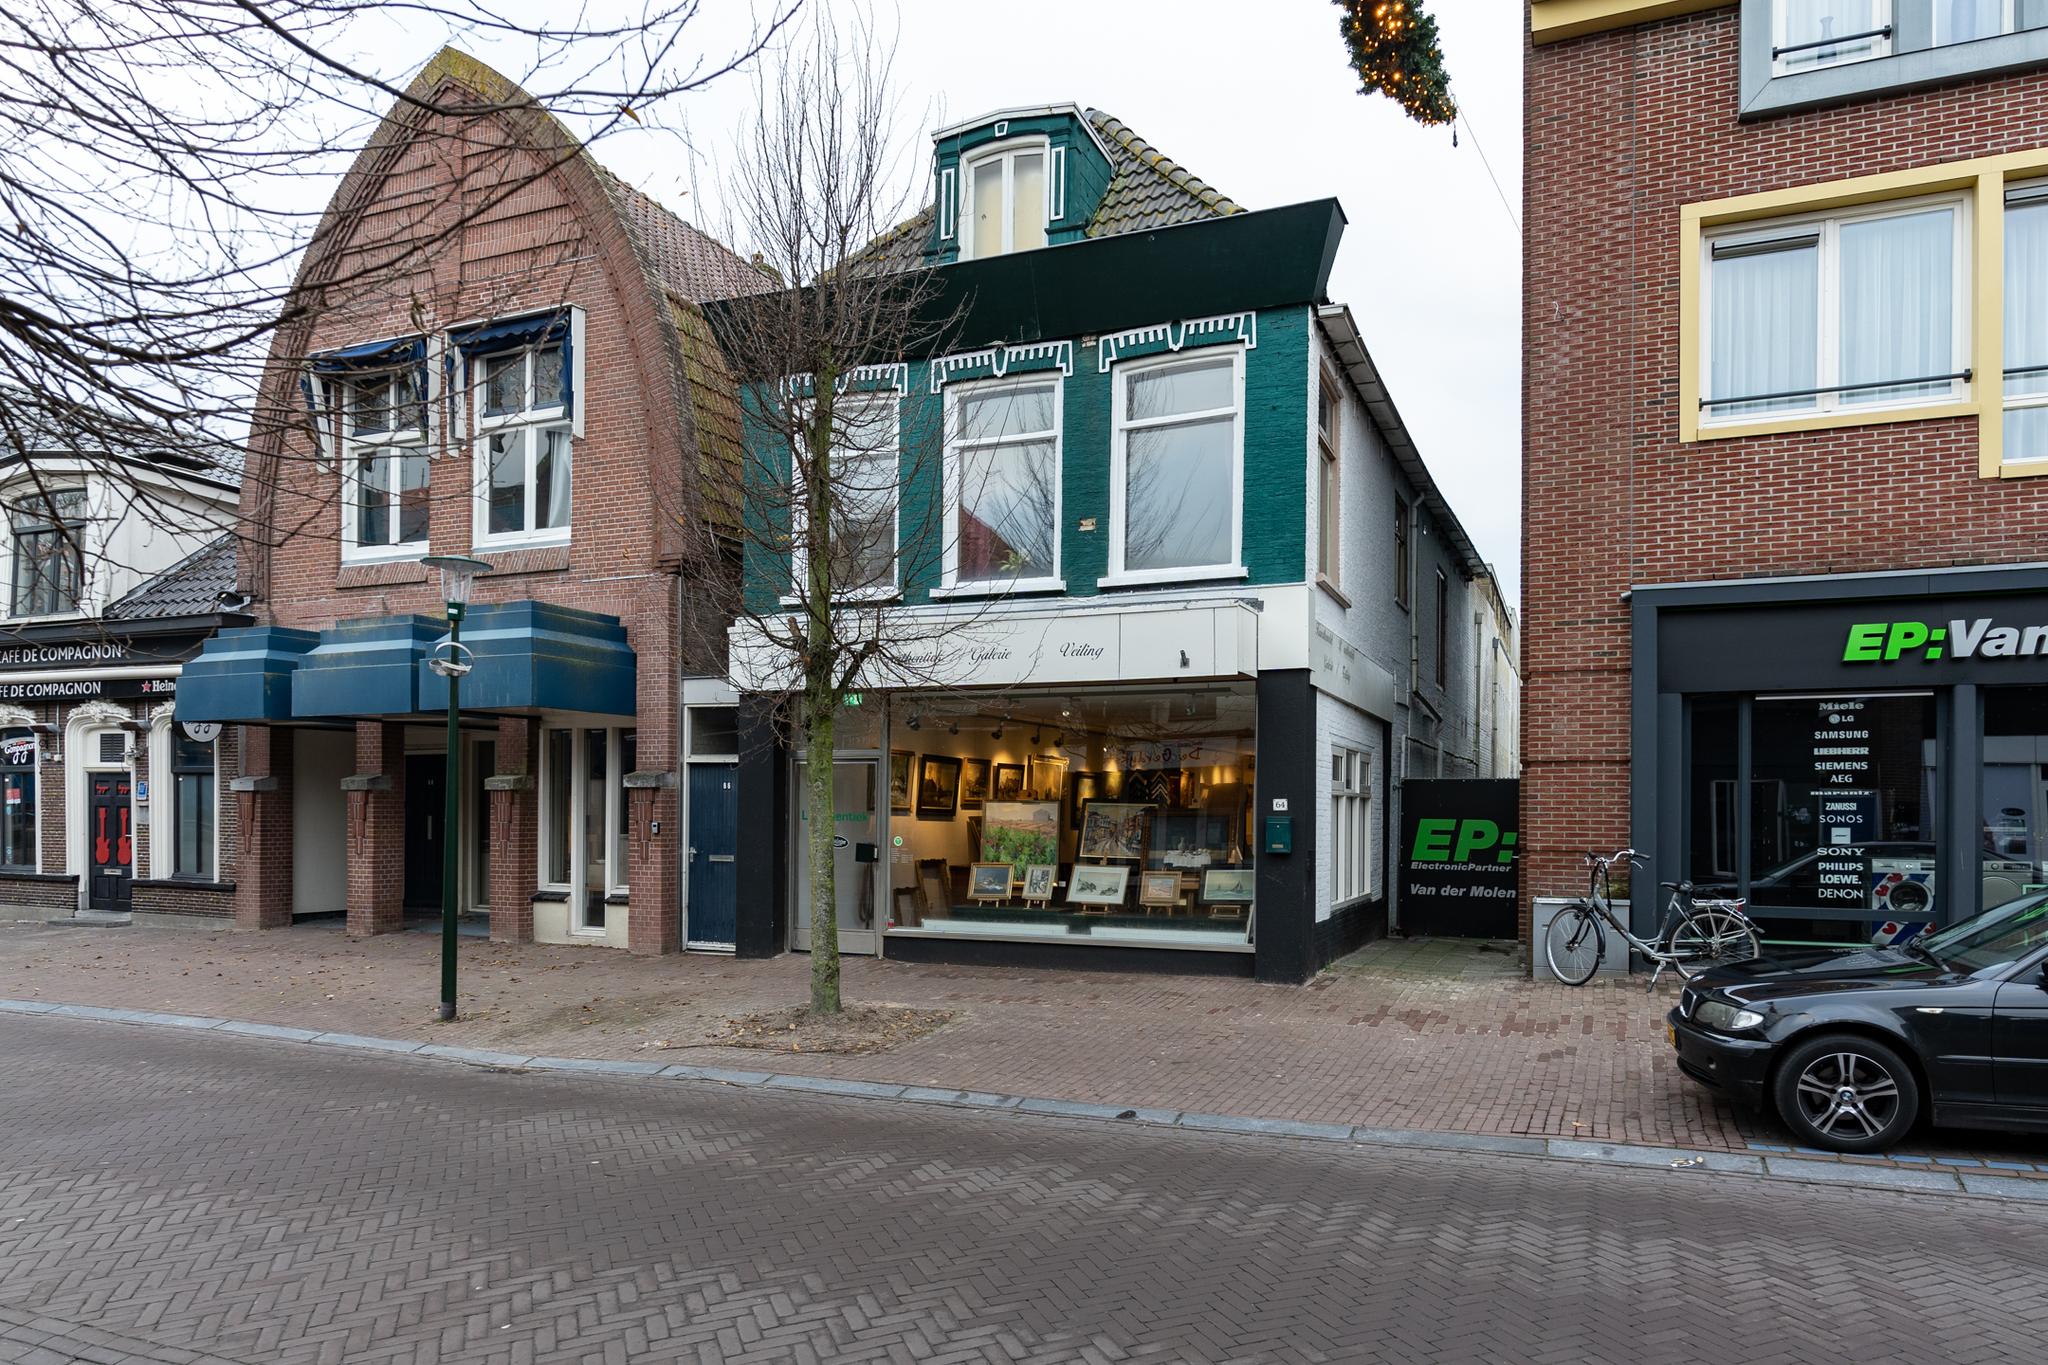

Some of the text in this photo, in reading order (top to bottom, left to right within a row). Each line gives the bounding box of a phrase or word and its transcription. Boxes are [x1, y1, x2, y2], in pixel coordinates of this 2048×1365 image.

[22, 648, 38, 663] DE
[40, 644, 122, 662] COMPAGNON
[968, 646, 1013, 666] Galerie
[1059, 642, 1104, 660] Veiling
[10, 684, 25, 698] DE
[26, 681, 101, 697] COMPAGNON
[1818, 702, 1865, 710] Miele
[1814, 730, 1869, 740] SAMSUNG
[1813, 747, 1870, 756] LIEBHERR
[1814, 761, 1869, 770] SIEMENS
[1830, 774, 1853, 783] AEG
[1825, 802, 1857, 811] ZANUSSI
[1819, 814, 1864, 824] SONOS
[1410, 818, 1518, 863] EP:
[1816, 847, 1865, 856] SONY
[1410, 861, 1512, 872] ElectronicPartner
[1817, 862, 1864, 871] PHILIPS
[1410, 883, 1517, 899] Van der Molen
[1818, 888, 1864, 899] DENON
